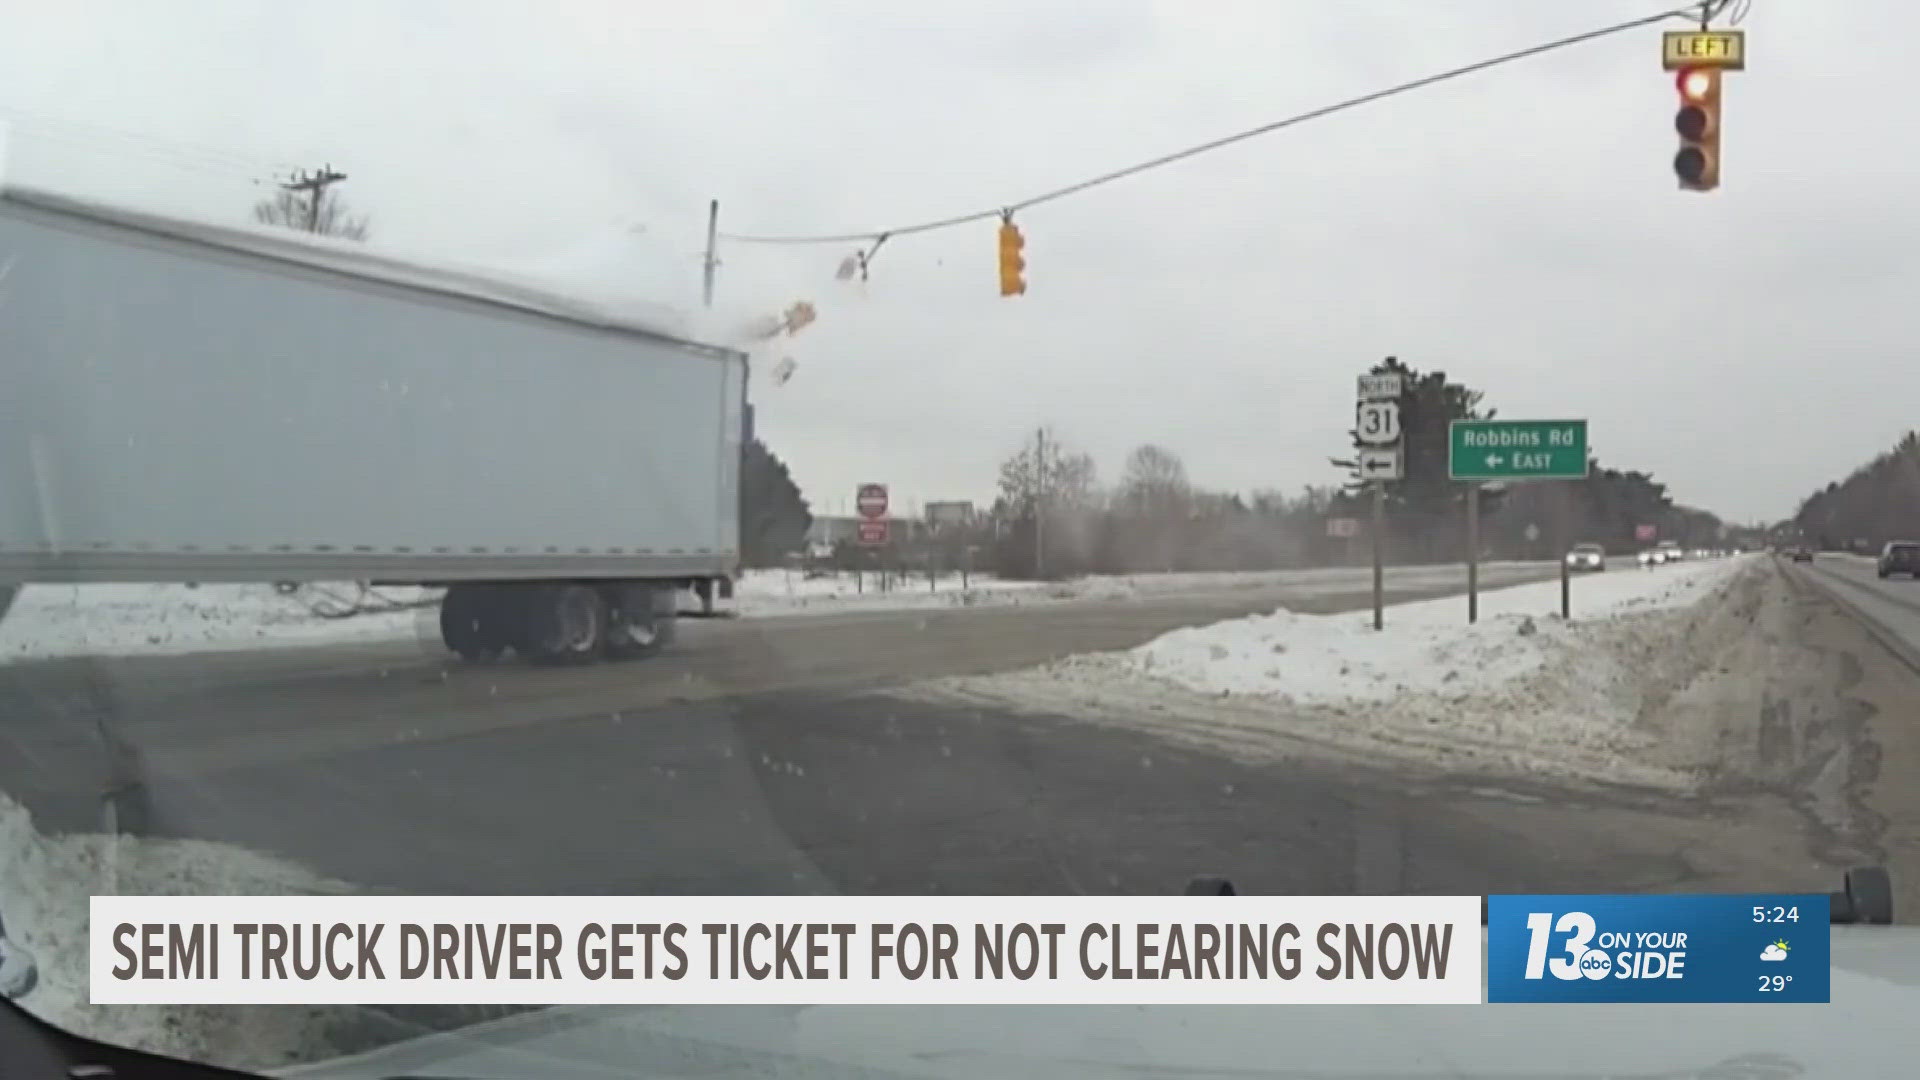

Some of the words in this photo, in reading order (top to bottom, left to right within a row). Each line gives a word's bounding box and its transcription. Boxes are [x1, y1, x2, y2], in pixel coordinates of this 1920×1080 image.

[1677, 37, 1730, 56] LEFT
[1365, 408, 1391, 434] 31
[1464, 429, 1541, 447] Robbins
[1550, 428, 1574, 446] Rd
[1512, 453, 1552, 469] EAST
